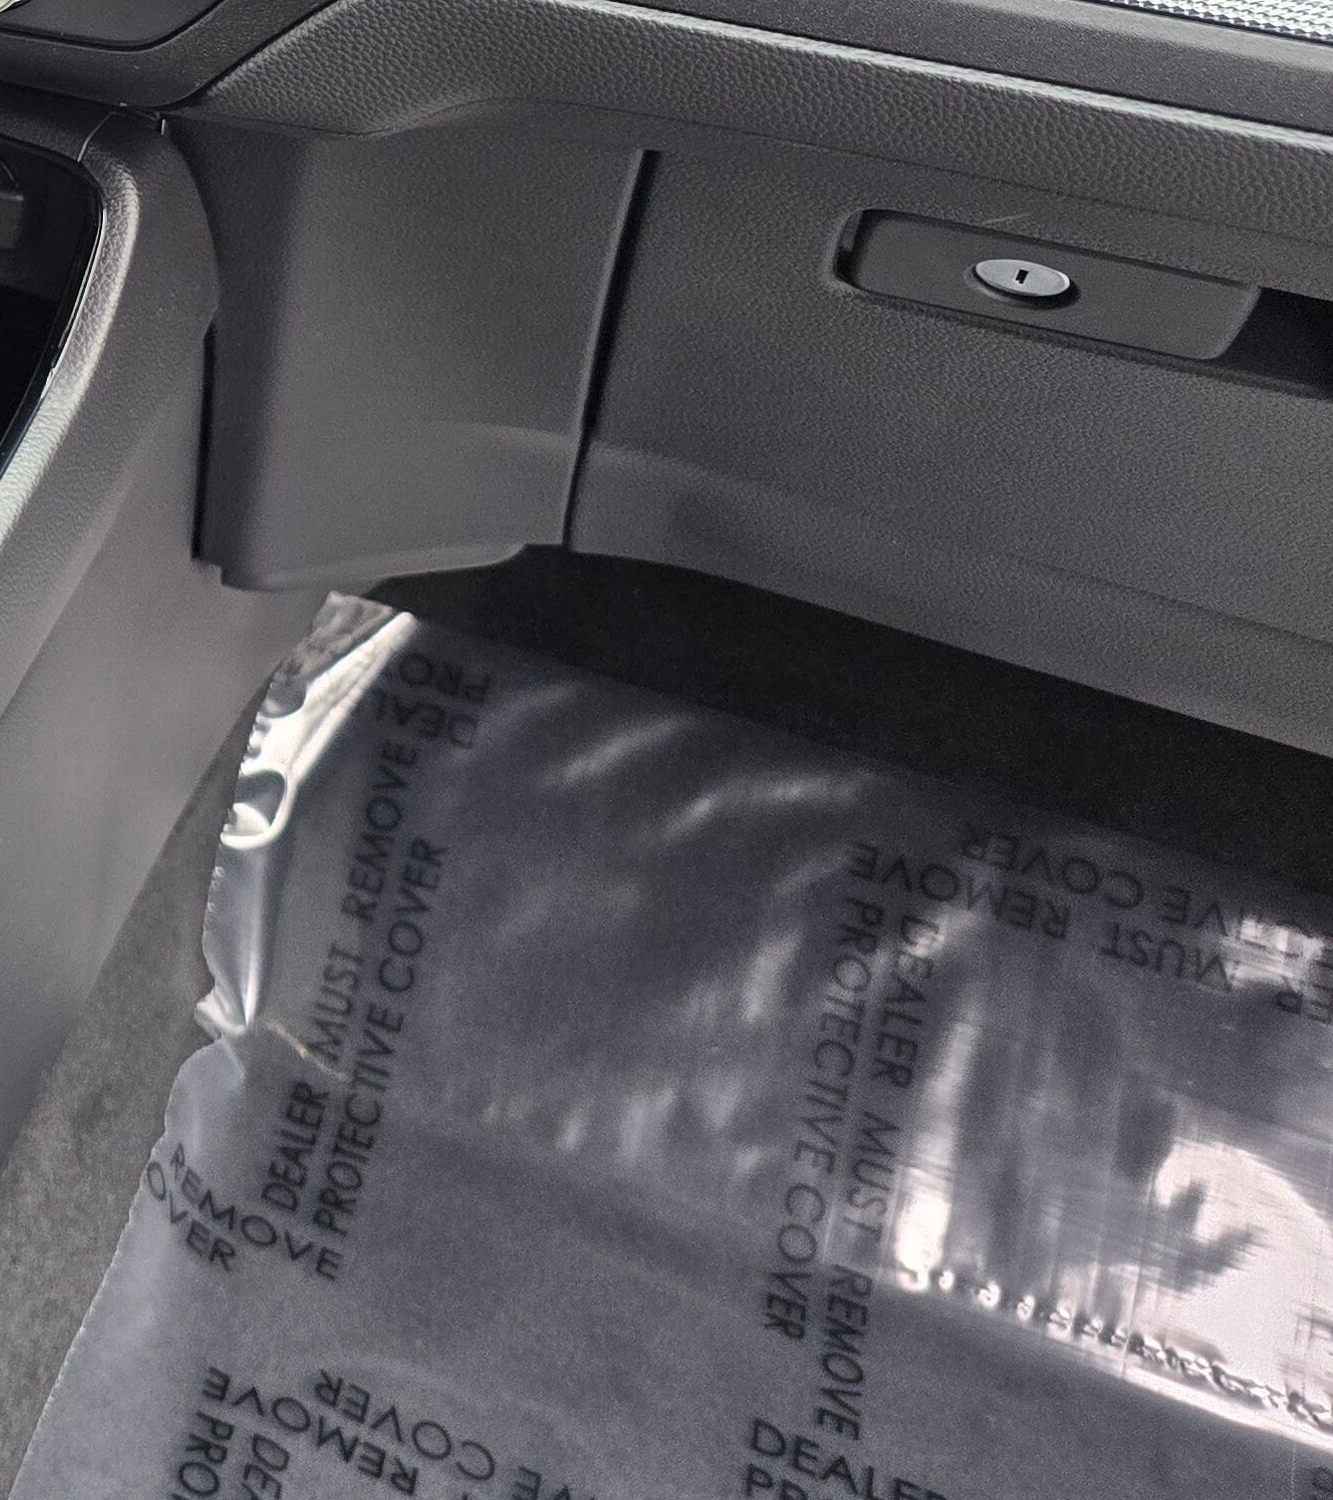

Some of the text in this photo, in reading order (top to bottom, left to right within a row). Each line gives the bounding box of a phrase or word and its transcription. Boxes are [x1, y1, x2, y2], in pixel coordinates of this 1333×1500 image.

[849, 843, 1071, 941] REMOVE
[962, 829, 1144, 910] COVER
[262, 741, 417, 1213] DEALER MUST REMOVE
[313, 838, 445, 1238] PROTECTIVE COVER
[762, 894, 884, 1340] PROTECTIVE COVER
[843, 1110, 900, 1242] MUST
[171, 1141, 342, 1282] REMOVE
[817, 1264, 873, 1440] REMOVE
[201, 1366, 419, 1496] REMOVE
[313, 1369, 495, 1481] COVER
